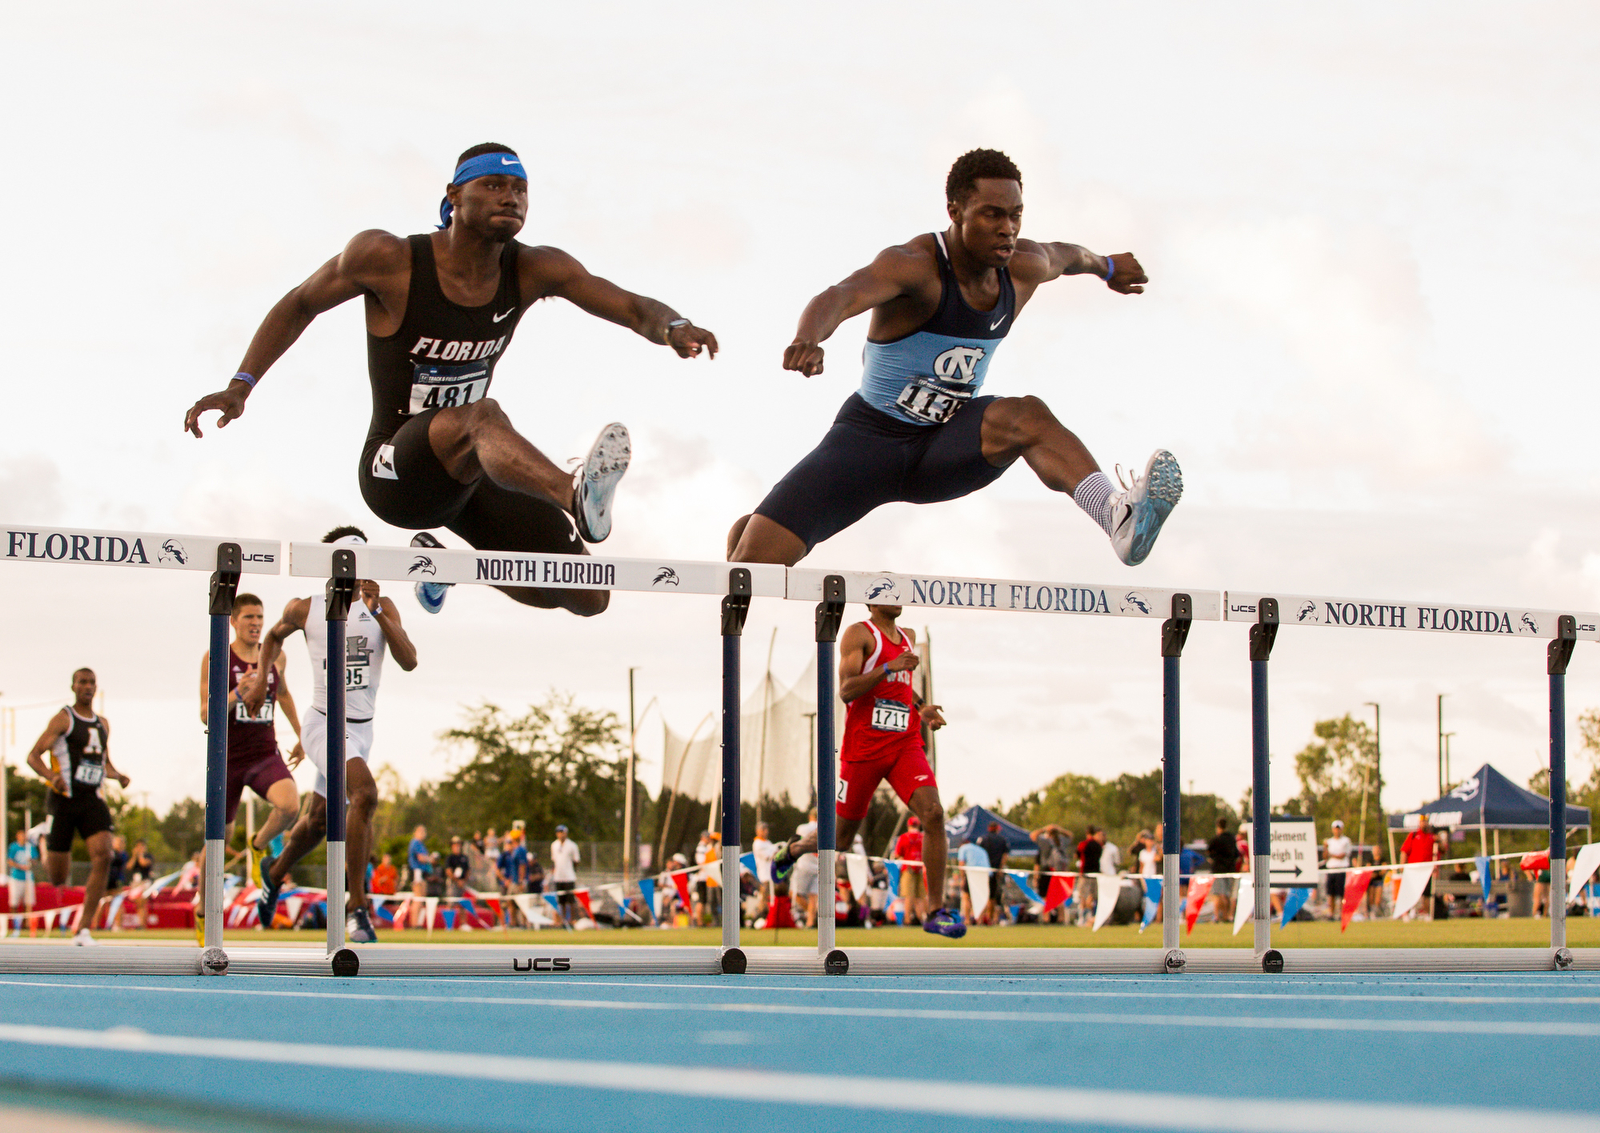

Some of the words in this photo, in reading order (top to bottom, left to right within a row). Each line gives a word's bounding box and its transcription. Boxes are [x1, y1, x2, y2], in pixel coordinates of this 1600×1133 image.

[410, 335, 506, 361] FLORIDA
[422, 383, 474, 409] 481
[6, 531, 150, 565] FLORIDA
[242, 553, 275, 563] UCS
[475, 557, 537, 582] NORTH
[542, 560, 616, 586] FLORIDA
[910, 579, 997, 608] NORTH
[1008, 584, 1111, 614] FLORIDA
[1230, 604, 1257, 613] UCS
[1324, 601, 1407, 628] NORTH
[1417, 607, 1514, 634] FLORIDA
[346, 668, 363, 685] 95
[874, 709, 906, 728] 1711
[83, 727, 102, 754] A
[1271, 849, 1291, 862] eigh
[513, 957, 571, 972] UCS
